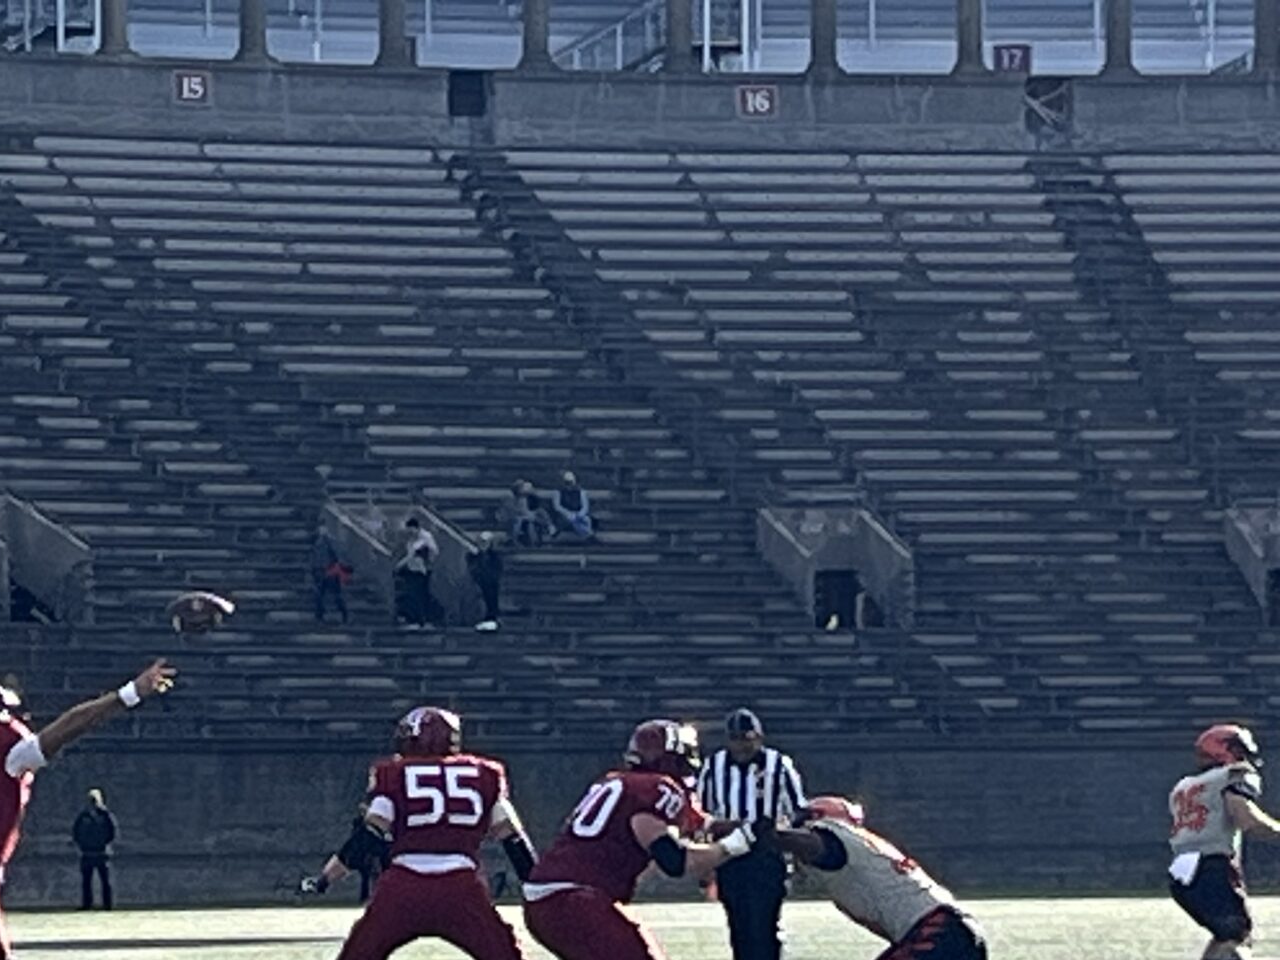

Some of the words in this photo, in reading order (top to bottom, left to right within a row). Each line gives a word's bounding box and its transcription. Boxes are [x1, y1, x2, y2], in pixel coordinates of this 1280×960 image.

[1001, 48, 1023, 71] 17
[181, 76, 205, 99] 15
[745, 89, 770, 114] 16
[404, 765, 484, 826] 55
[655, 783, 686, 818] 70
